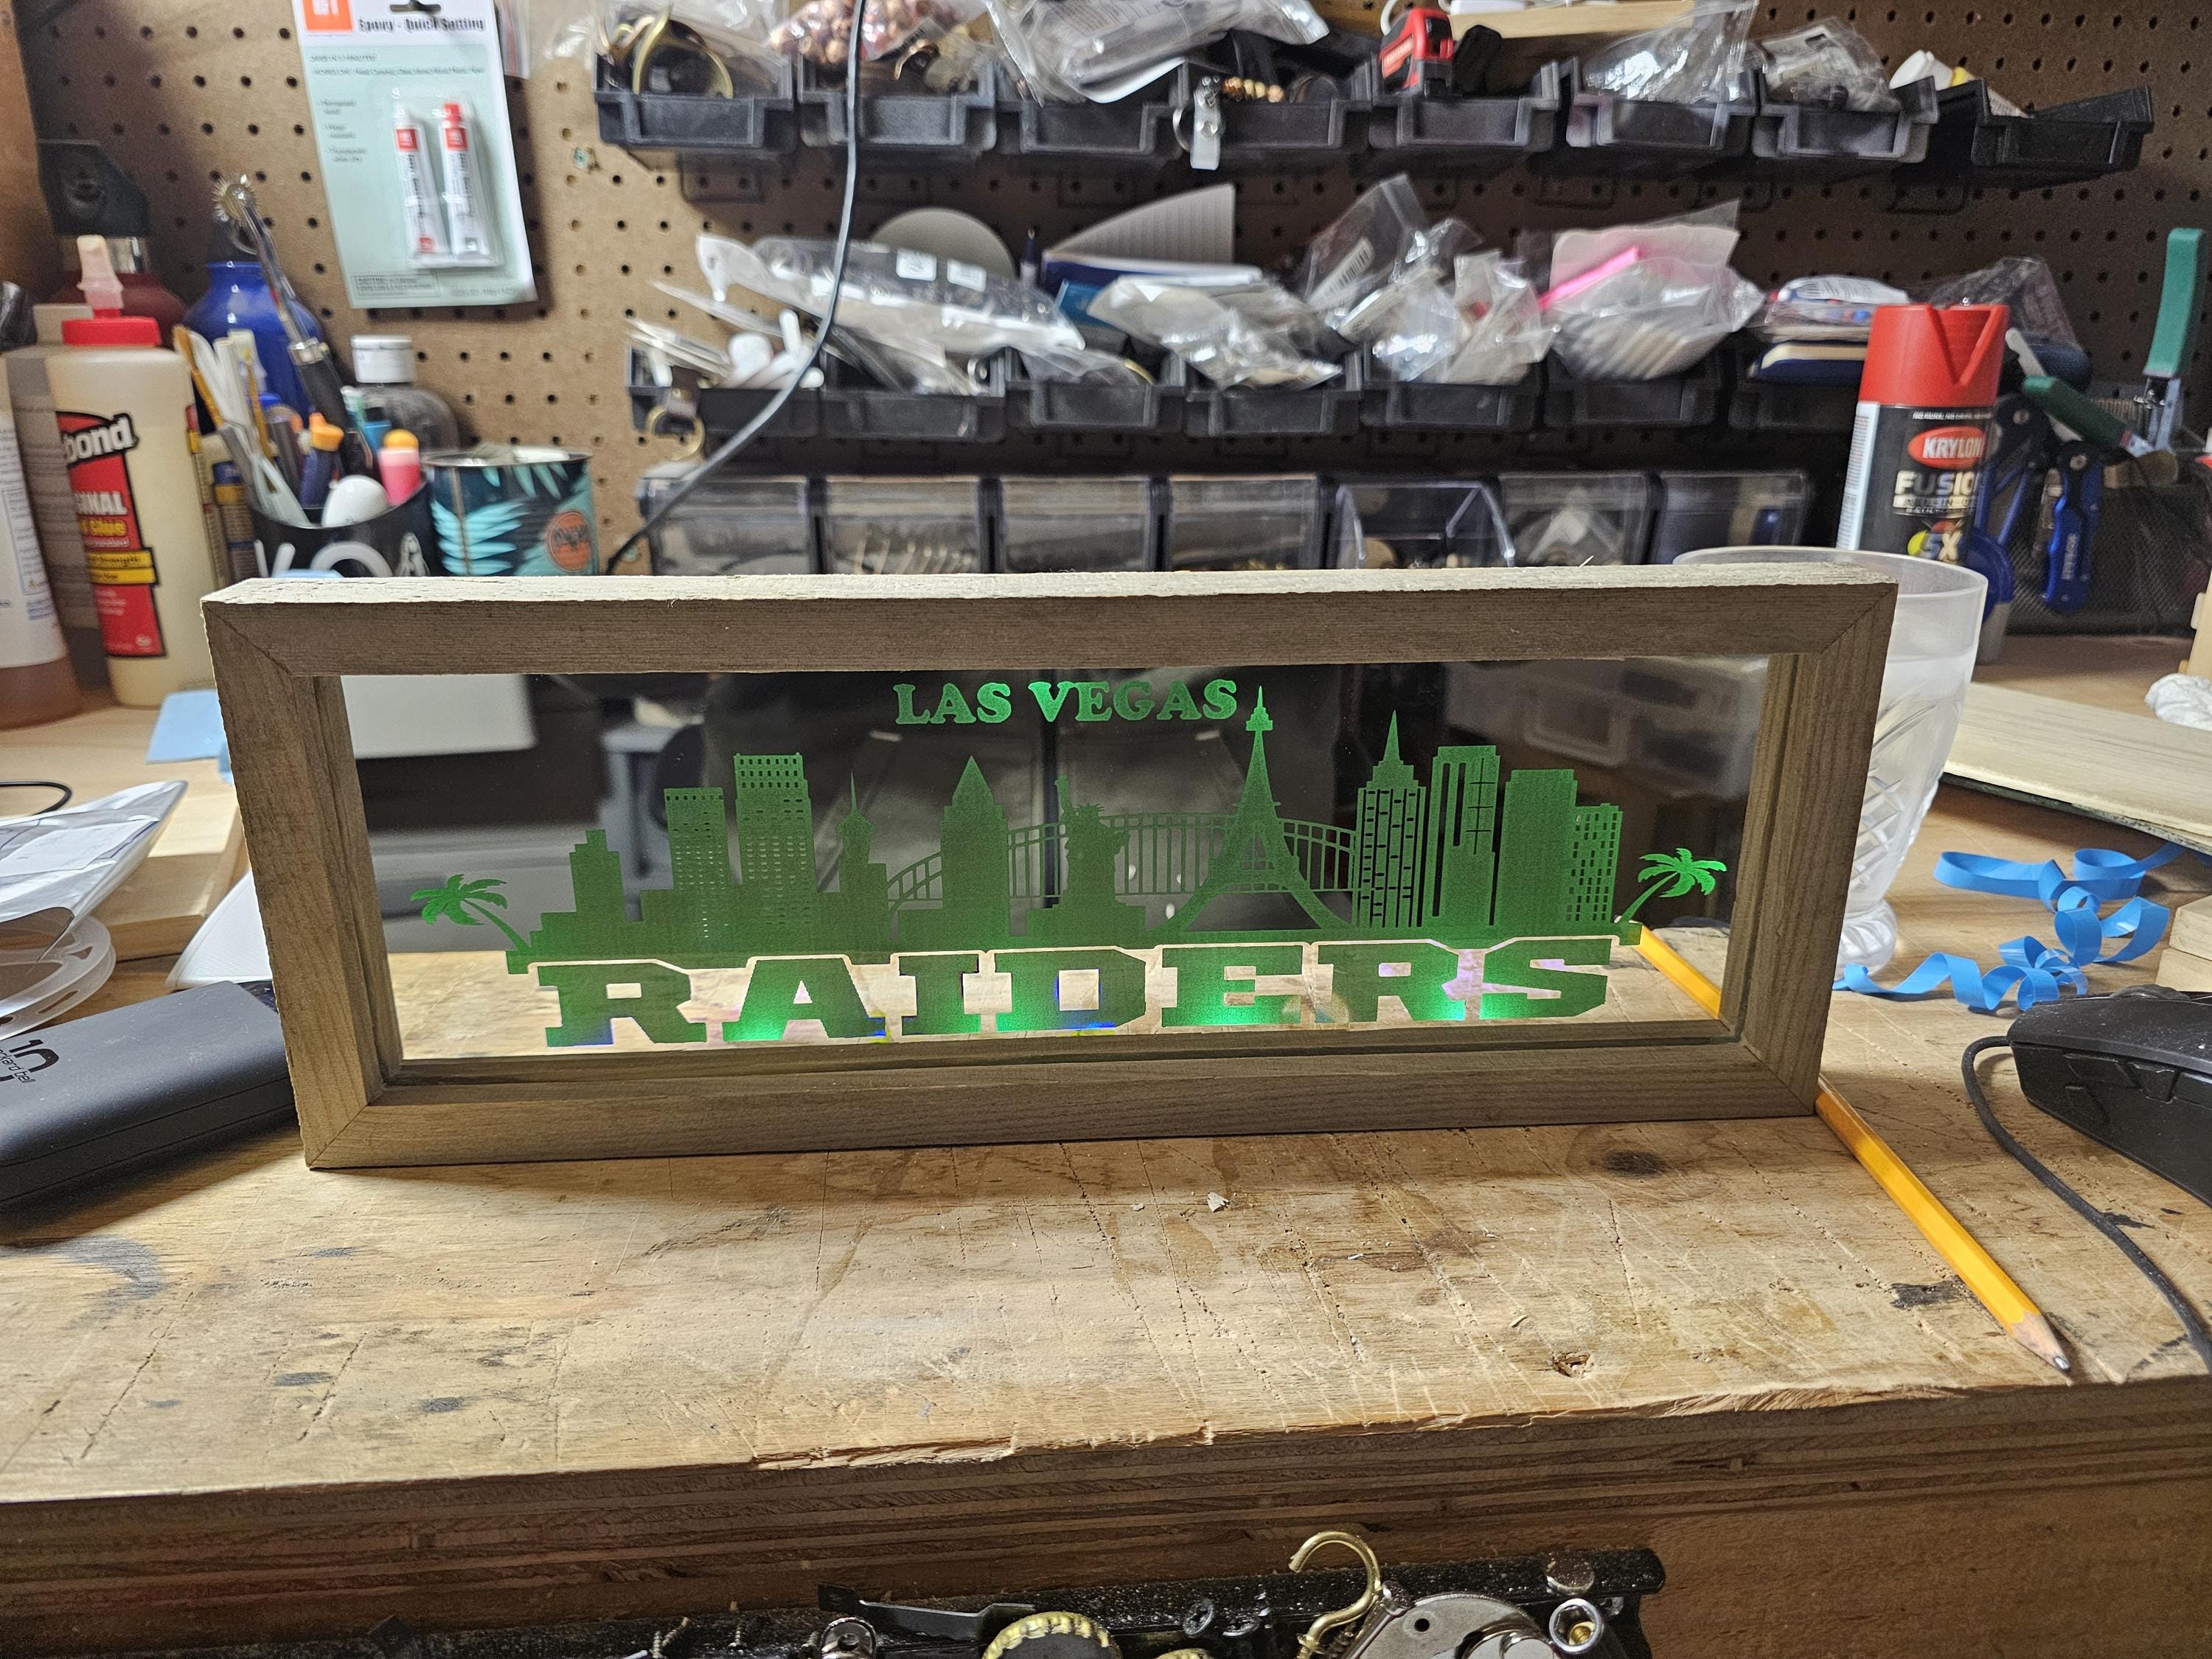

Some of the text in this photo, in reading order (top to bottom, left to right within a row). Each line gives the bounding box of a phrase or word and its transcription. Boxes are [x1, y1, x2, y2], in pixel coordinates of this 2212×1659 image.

[892, 679, 1237, 725] LAS VEGAS
[538, 937, 1611, 1046] RAIDERS
